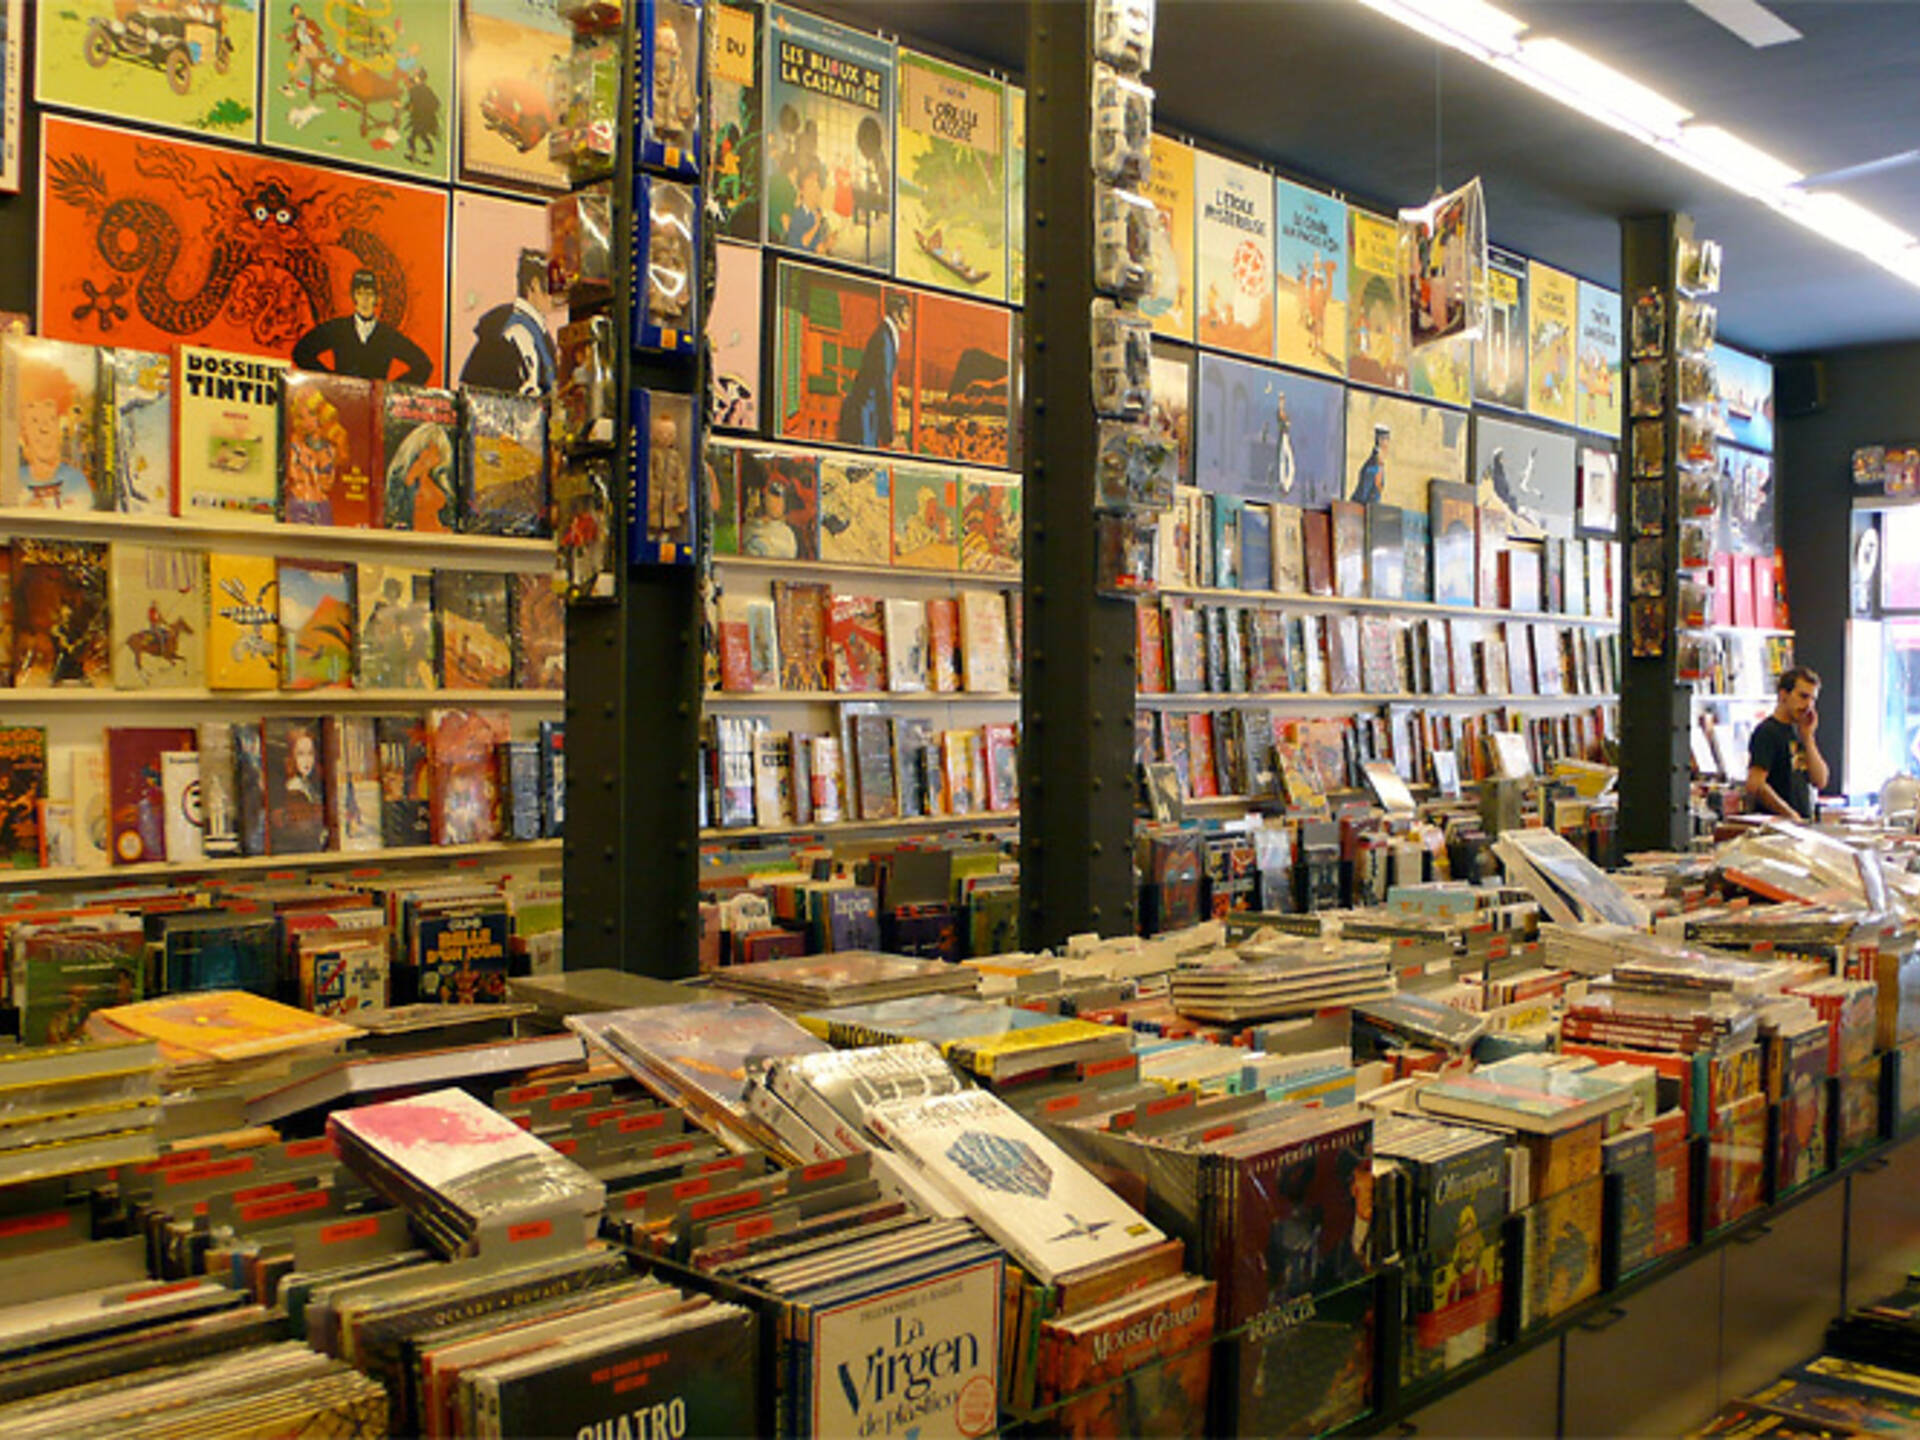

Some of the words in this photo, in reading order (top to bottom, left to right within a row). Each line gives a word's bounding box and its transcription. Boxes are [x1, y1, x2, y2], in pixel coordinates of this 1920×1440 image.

[781, 41, 804, 65] LES
[810, 52, 859, 83] BIJOUX
[864, 70, 881, 90] DE
[781, 62, 800, 84] LA
[803, 69, 880, 109] CASTAFIORE
[186, 373, 278, 405] TINTIN
[895, 1316, 924, 1347] La
[838, 1332, 978, 1416] Virgen
[858, 1412, 877, 1437] de
